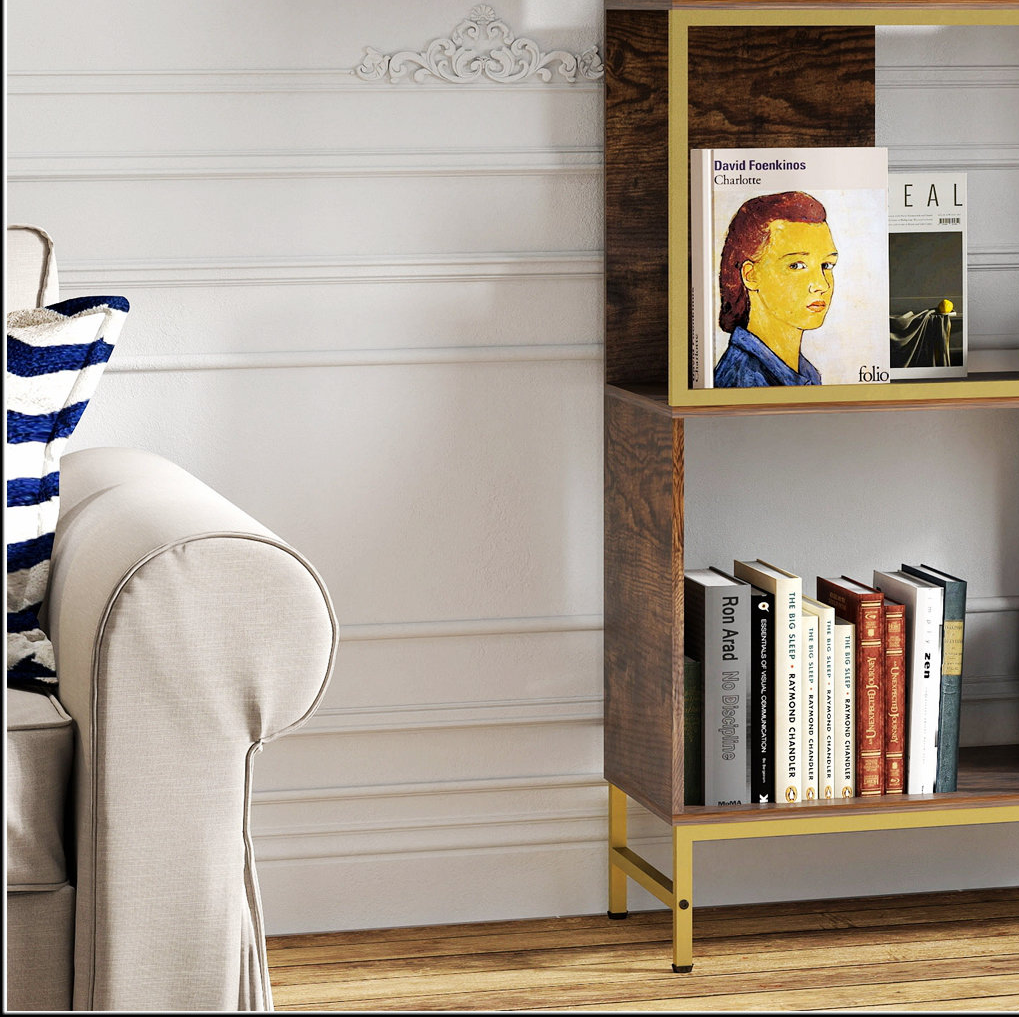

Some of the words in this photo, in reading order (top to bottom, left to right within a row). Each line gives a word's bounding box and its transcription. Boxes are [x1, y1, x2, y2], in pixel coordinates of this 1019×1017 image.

[714, 160, 746, 171] David
[749, 159, 807, 171] Foenkinos
[714, 174, 762, 185] Charlotte
[888, 183, 963, 207] EAL
[858, 365, 890, 382] folio
[722, 596, 739, 624] Ron
[788, 592, 796, 609] THE
[788, 613, 796, 630] BIG
[722, 628, 739, 661] Arad
[788, 633, 796, 660] SLEEP
[760, 659, 767, 670] OF
[923, 652, 931, 679] zen
[721, 670, 740, 691] No
[788, 673, 796, 723] RAYMOND
[718, 694, 740, 761] Discipline
[788, 726, 796, 778] CHANDLER
